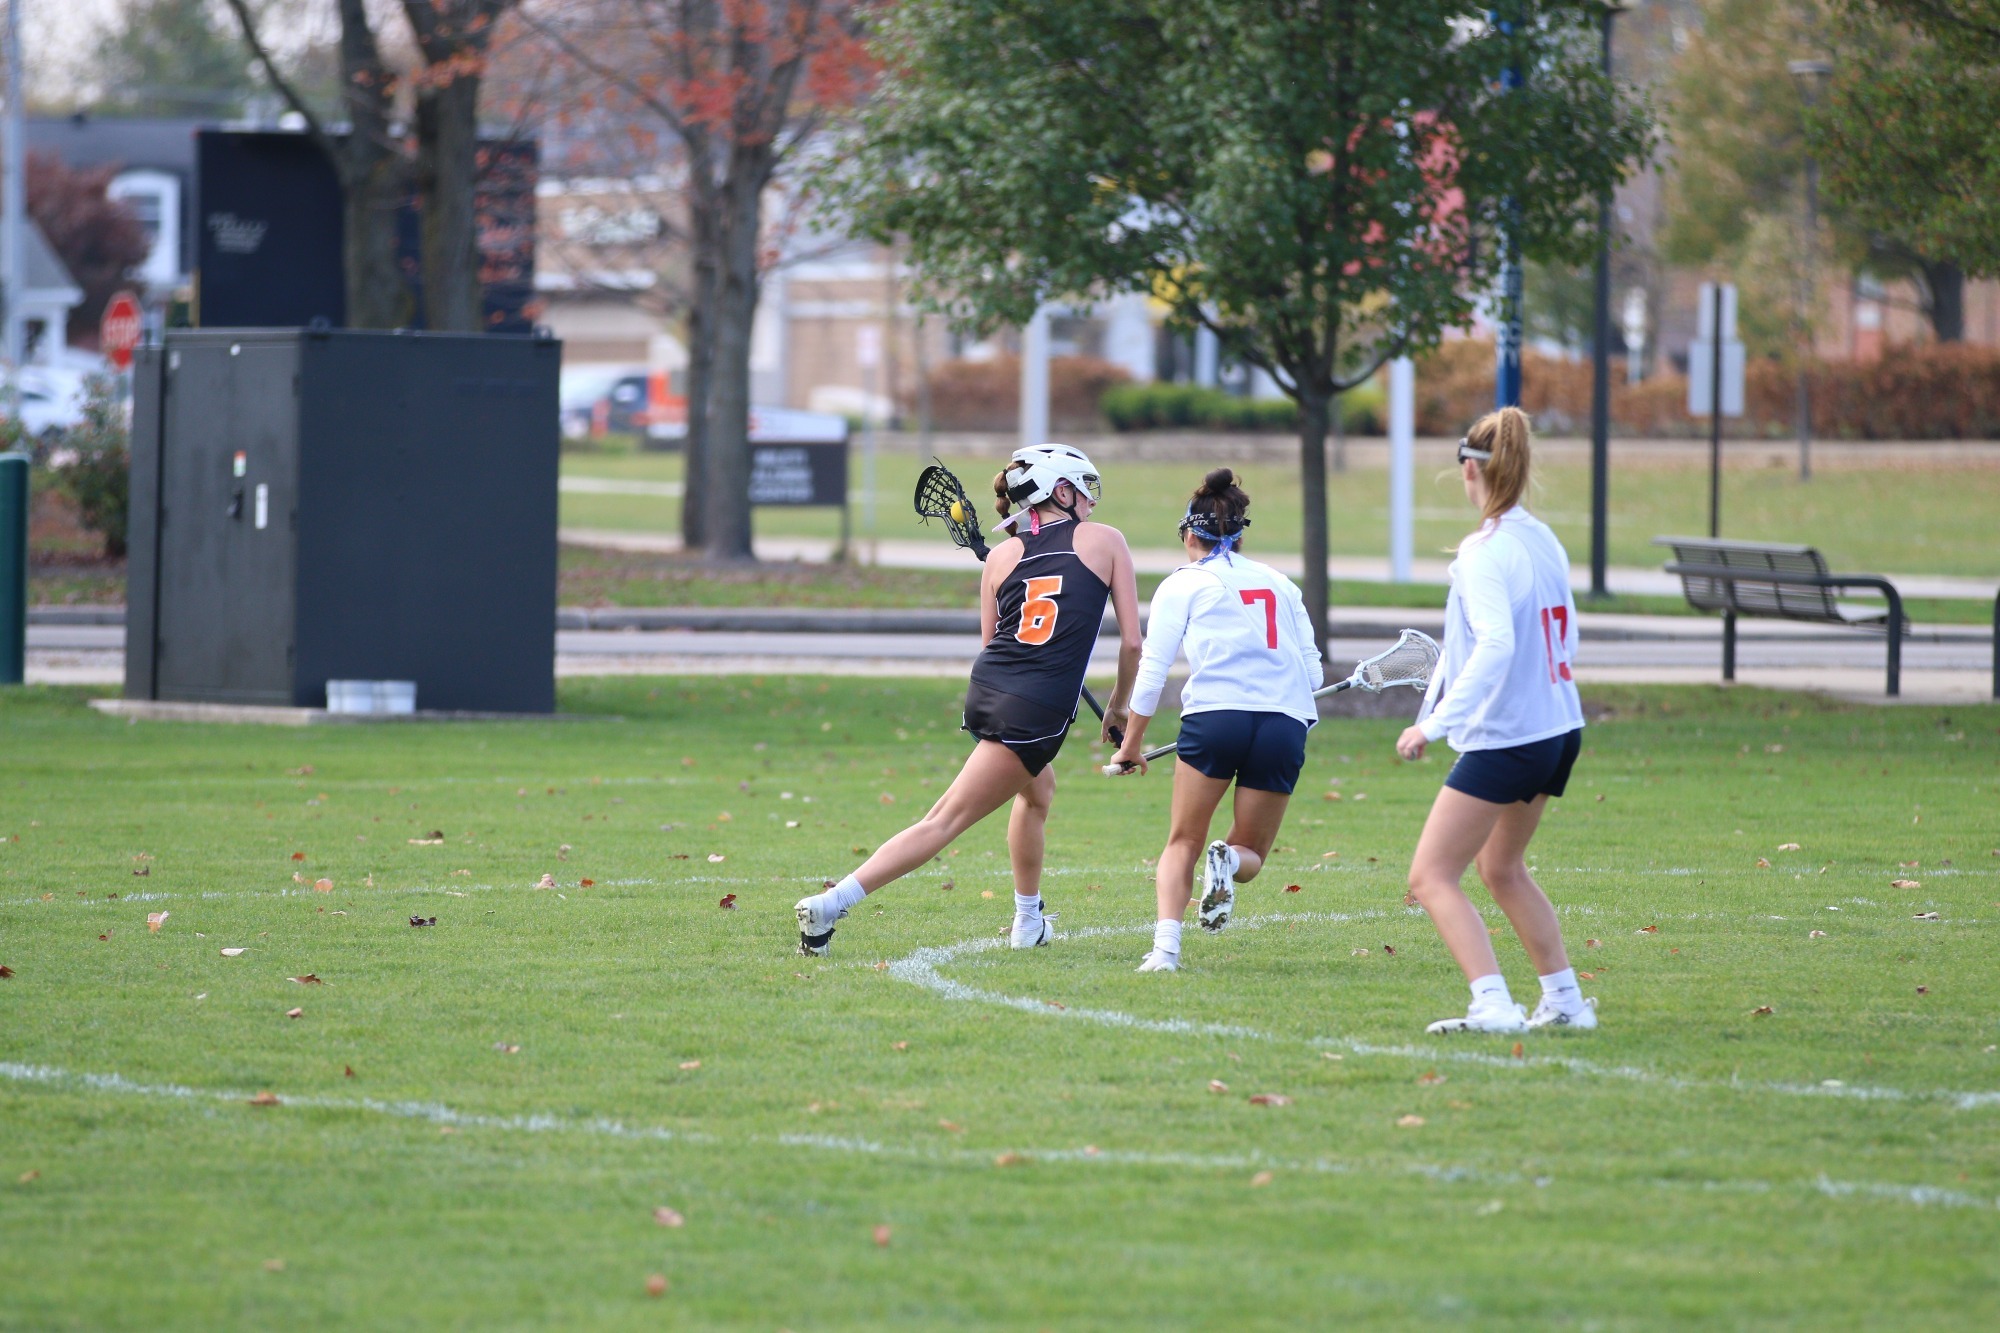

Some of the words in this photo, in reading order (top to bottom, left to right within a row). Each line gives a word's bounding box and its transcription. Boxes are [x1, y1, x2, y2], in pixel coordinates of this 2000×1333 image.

[1190, 512, 1204, 521] STX
[1014, 575, 1063, 645] 6
[1238, 588, 1278, 650] 7
